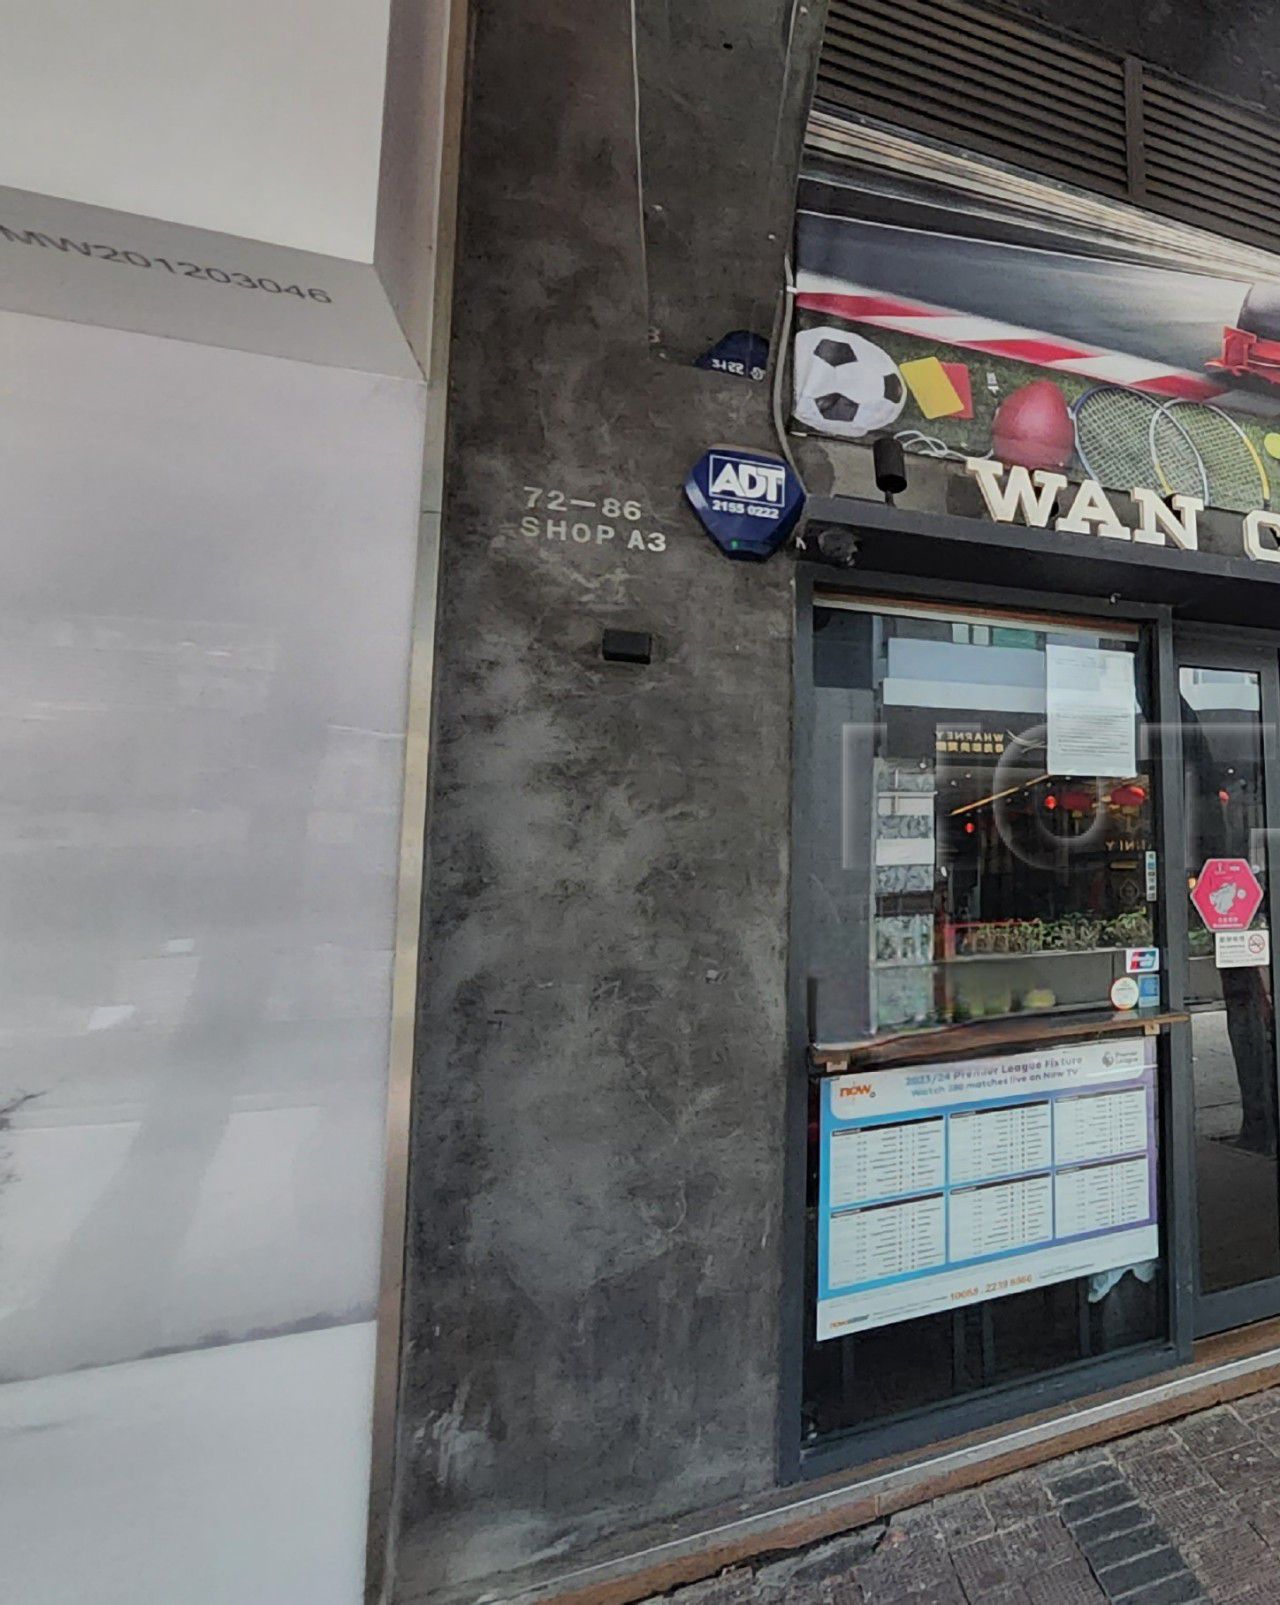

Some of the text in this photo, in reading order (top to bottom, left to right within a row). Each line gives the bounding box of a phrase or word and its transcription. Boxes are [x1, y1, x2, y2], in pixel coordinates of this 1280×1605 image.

[711, 463, 784, 502] ADT
[966, 458, 1204, 551] WAN
[520, 517, 667, 551] SHOP A3
[1002, 1062, 1042, 1075] League
